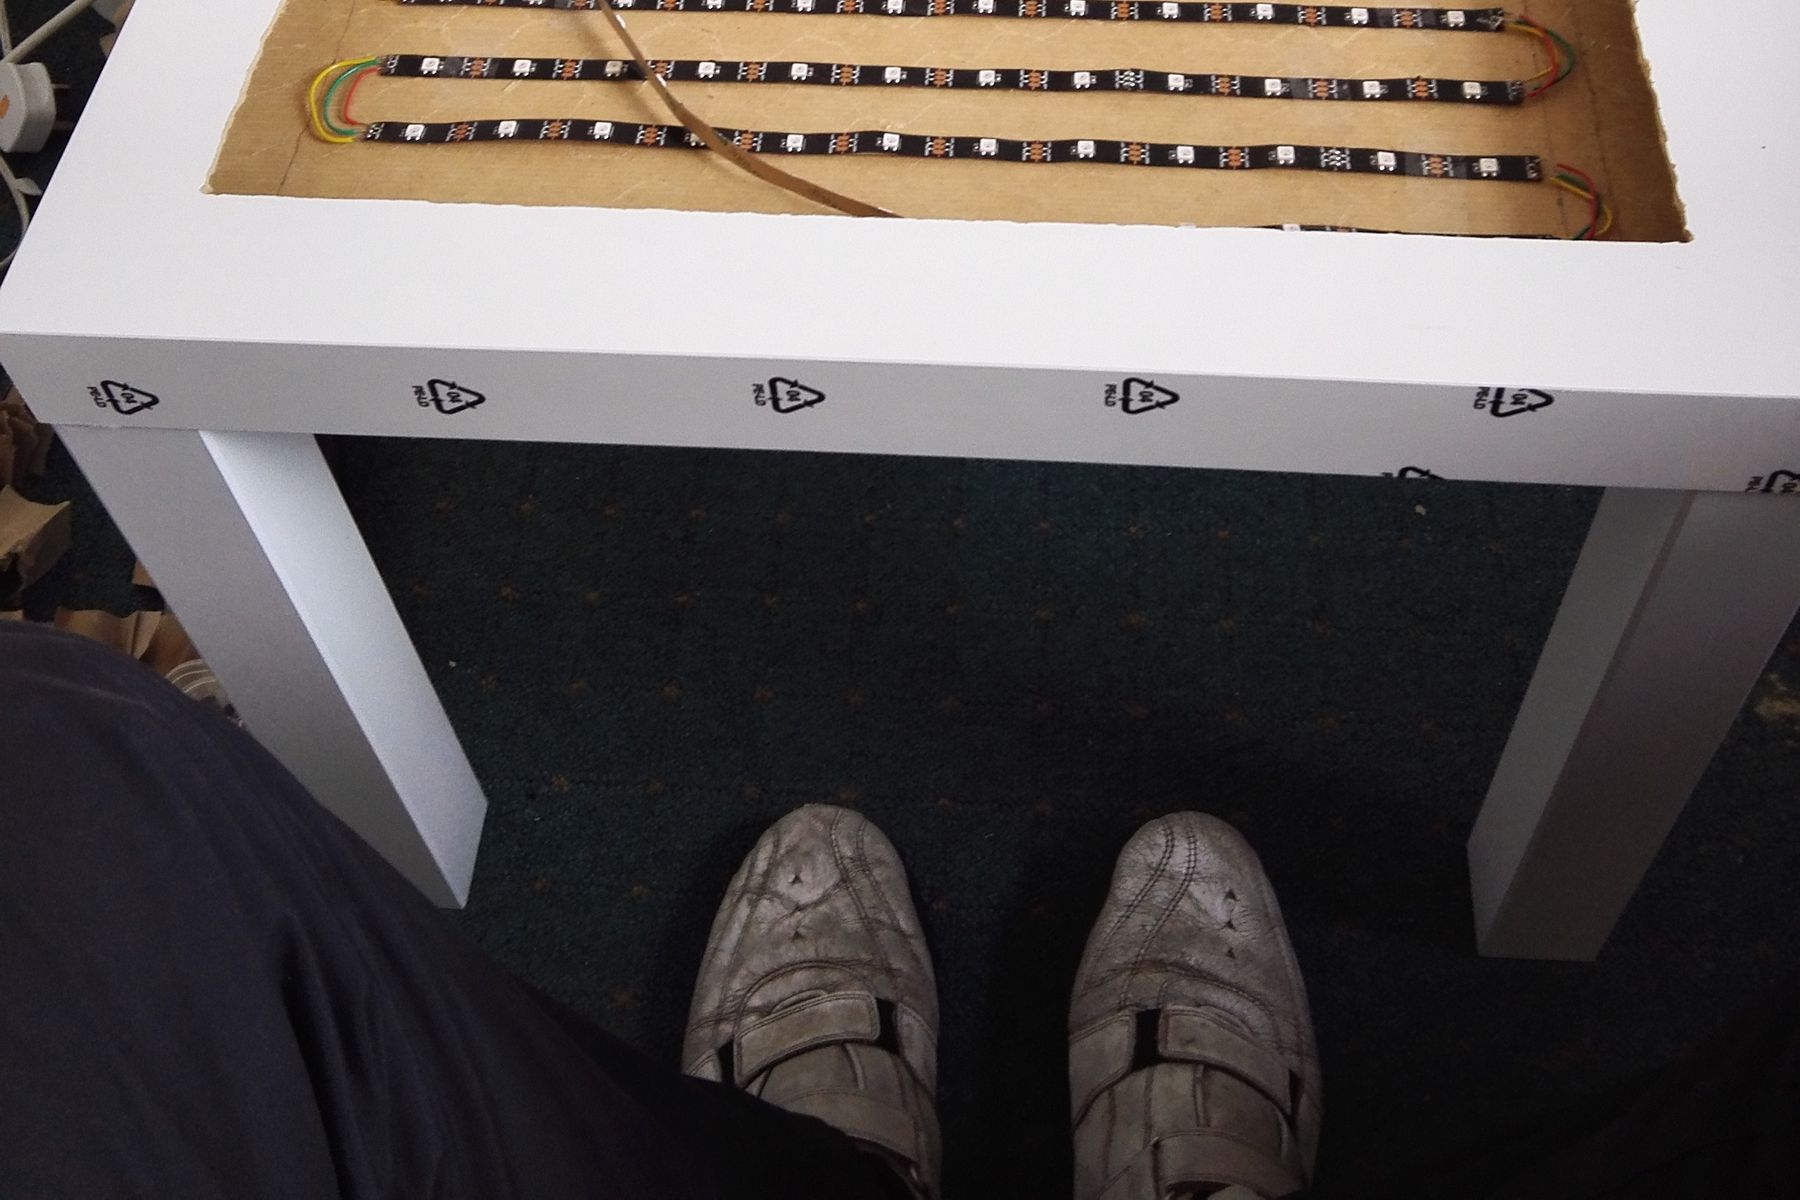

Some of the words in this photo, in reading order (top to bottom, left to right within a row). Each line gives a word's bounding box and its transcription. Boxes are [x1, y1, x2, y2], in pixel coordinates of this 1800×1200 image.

[120, 392, 138, 404] 04
[446, 391, 463, 403] 04
[786, 390, 801, 402] 04
[1138, 390, 1154, 403] 04
[1510, 393, 1528, 405] 04
